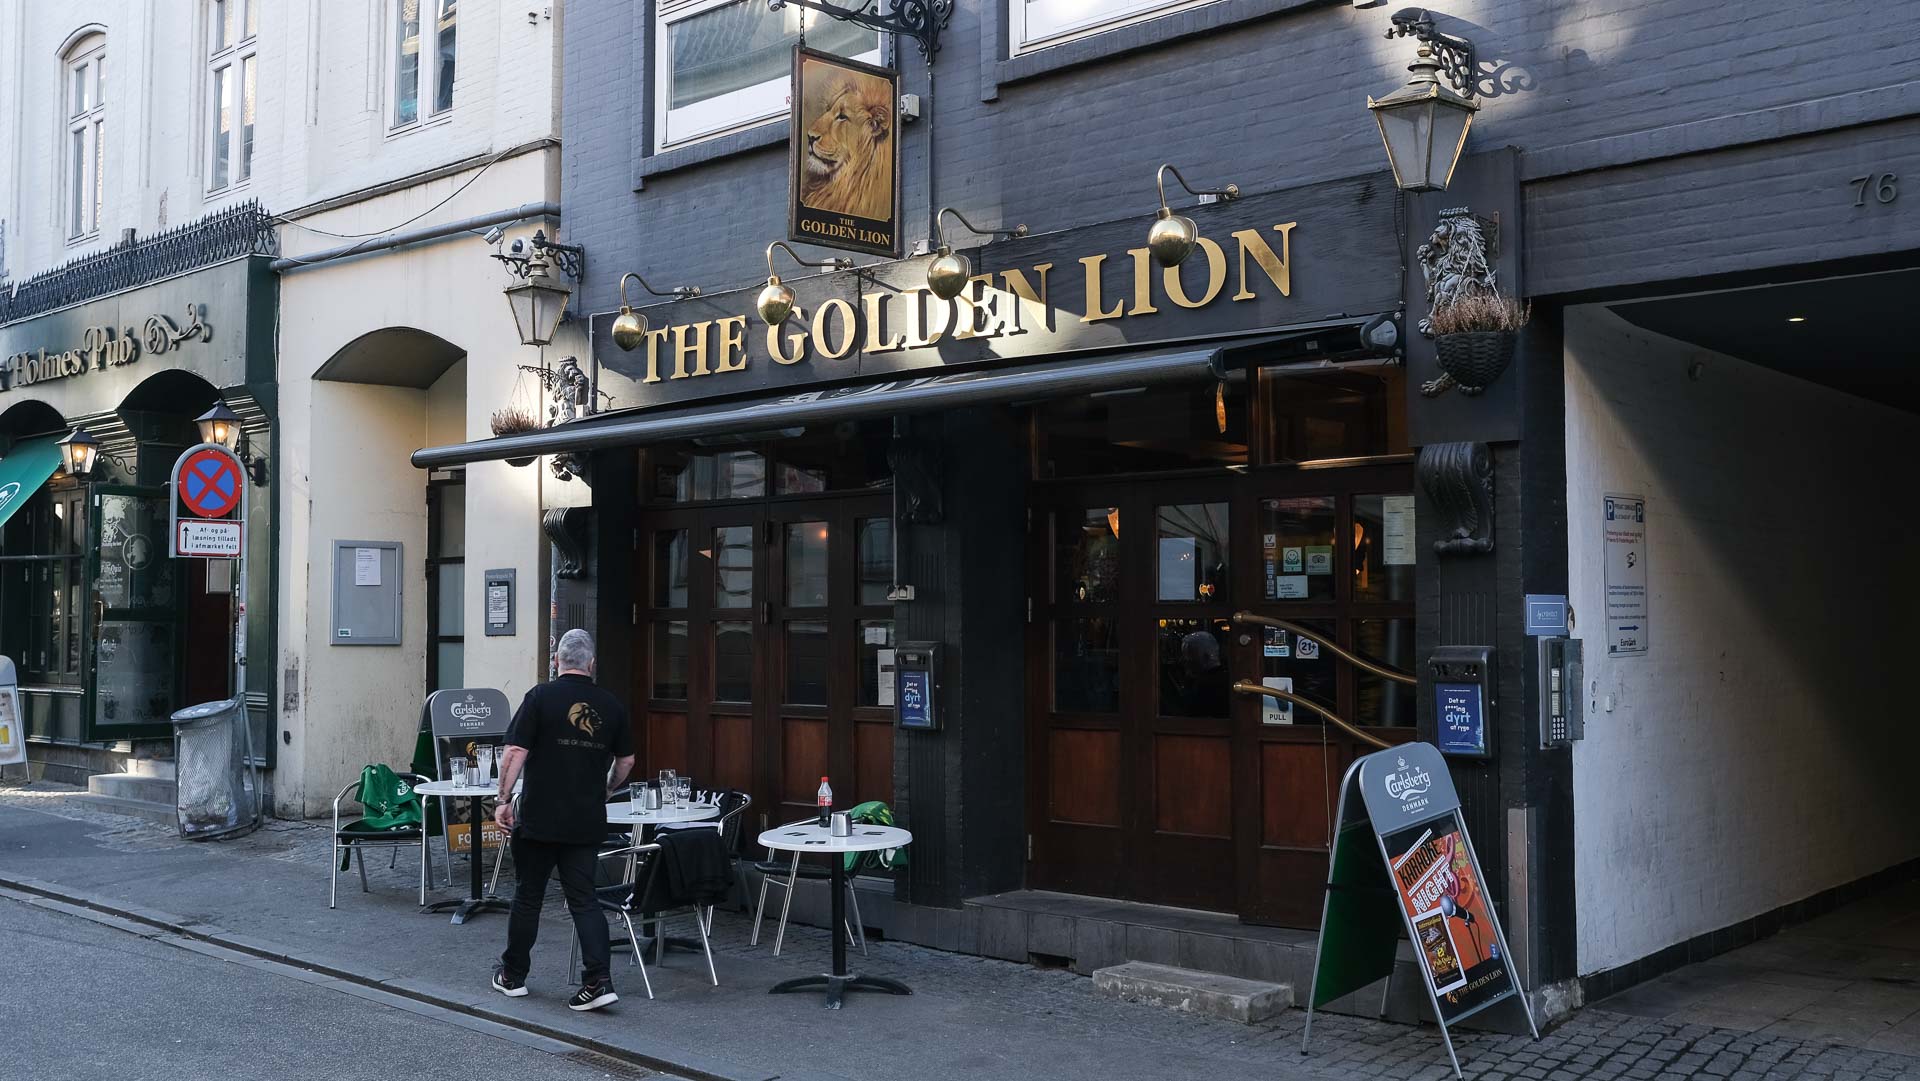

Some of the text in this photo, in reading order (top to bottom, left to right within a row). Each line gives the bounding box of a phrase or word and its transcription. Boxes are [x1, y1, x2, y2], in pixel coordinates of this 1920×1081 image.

[1849, 172, 1897, 207] 76
[801, 219, 890, 246] GOLDEN LION
[839, 217, 855, 227] THE
[642, 221, 1297, 384] THE GOLDEN LION
[7, 324, 135, 388] Holmes Pub
[1301, 641, 1316, 652] 21+
[450, 702, 492, 721] Carlsberg
[1269, 713, 1287, 721] PULL
[1445, 712, 1471, 726] dyrt
[1384, 766, 1431, 800] Carlsberg
[1401, 797, 1430, 812] DENMARK
[481, 829, 504, 843] FRE
[1397, 840, 1442, 890] KARAOKE
[1411, 861, 1454, 915] NIGHT
